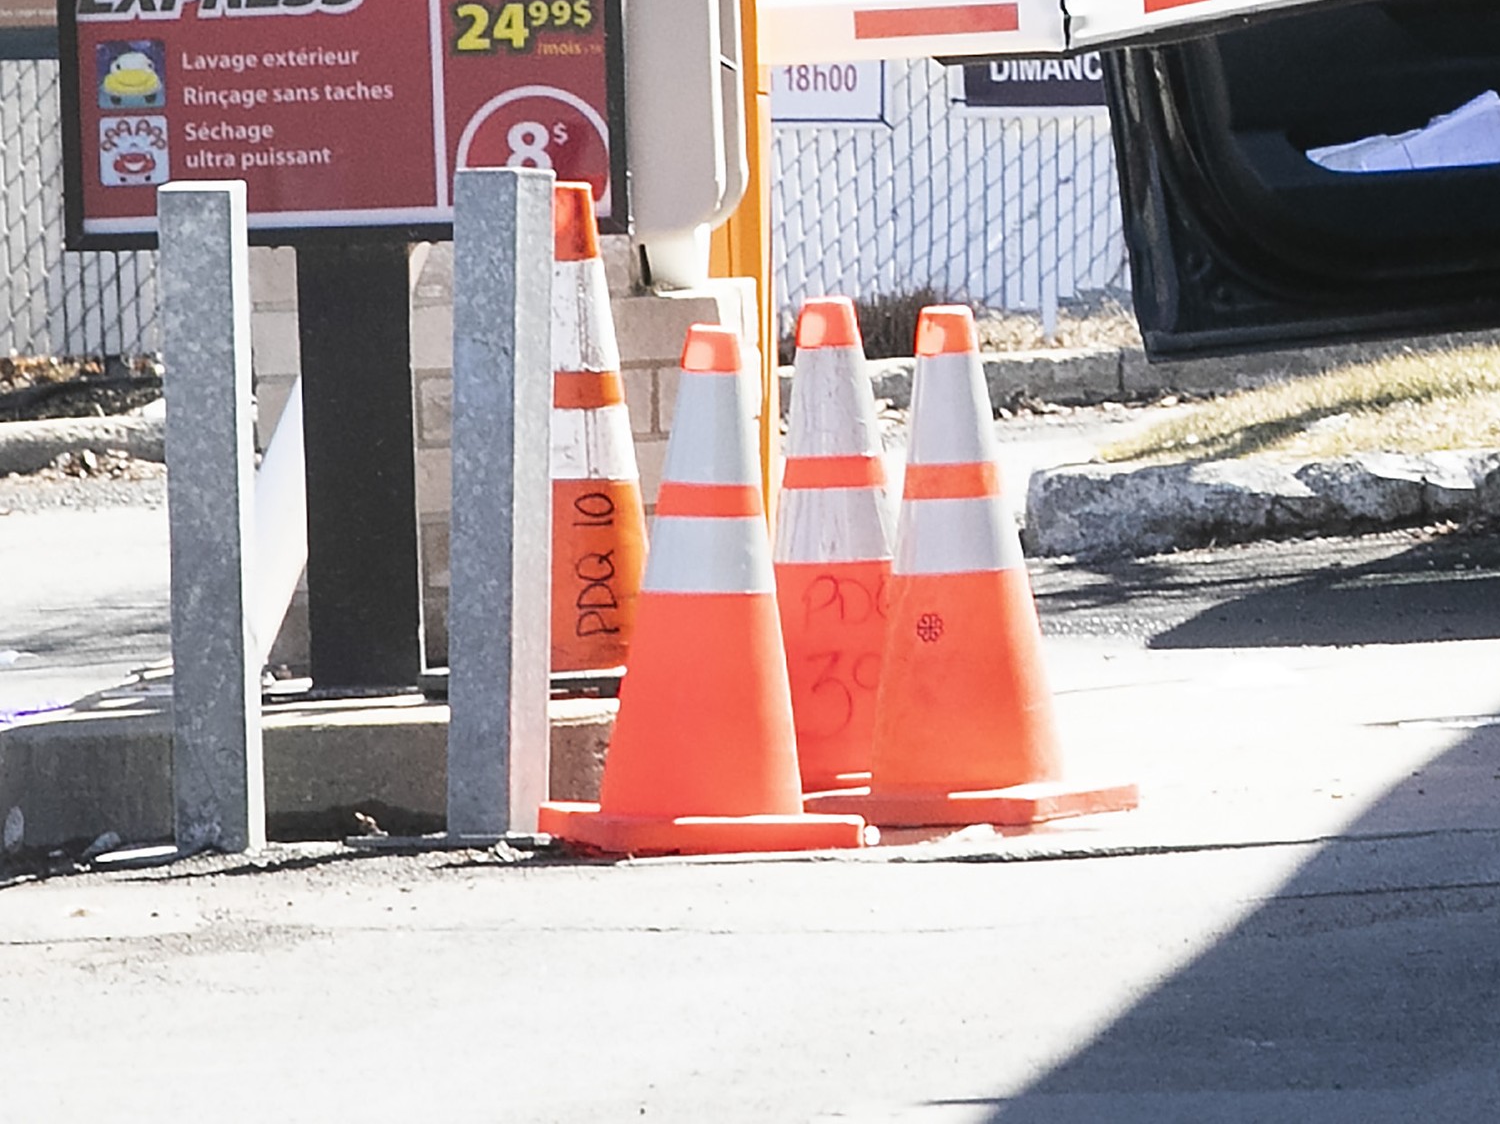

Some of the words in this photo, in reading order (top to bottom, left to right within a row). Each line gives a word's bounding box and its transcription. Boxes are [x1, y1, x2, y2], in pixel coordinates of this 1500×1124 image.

[181, 51, 258, 72] Lavage
[262, 47, 360, 68] extérieur
[784, 65, 857, 92] 18h00
[182, 86, 268, 110] Rinçage
[272, 86, 319, 104] sans
[324, 82, 394, 101] taches
[184, 122, 274, 144] Séchage
[185, 149, 237, 168] ultra
[240, 147, 332, 170] puissant
[577, 549, 619, 639] PDQ
